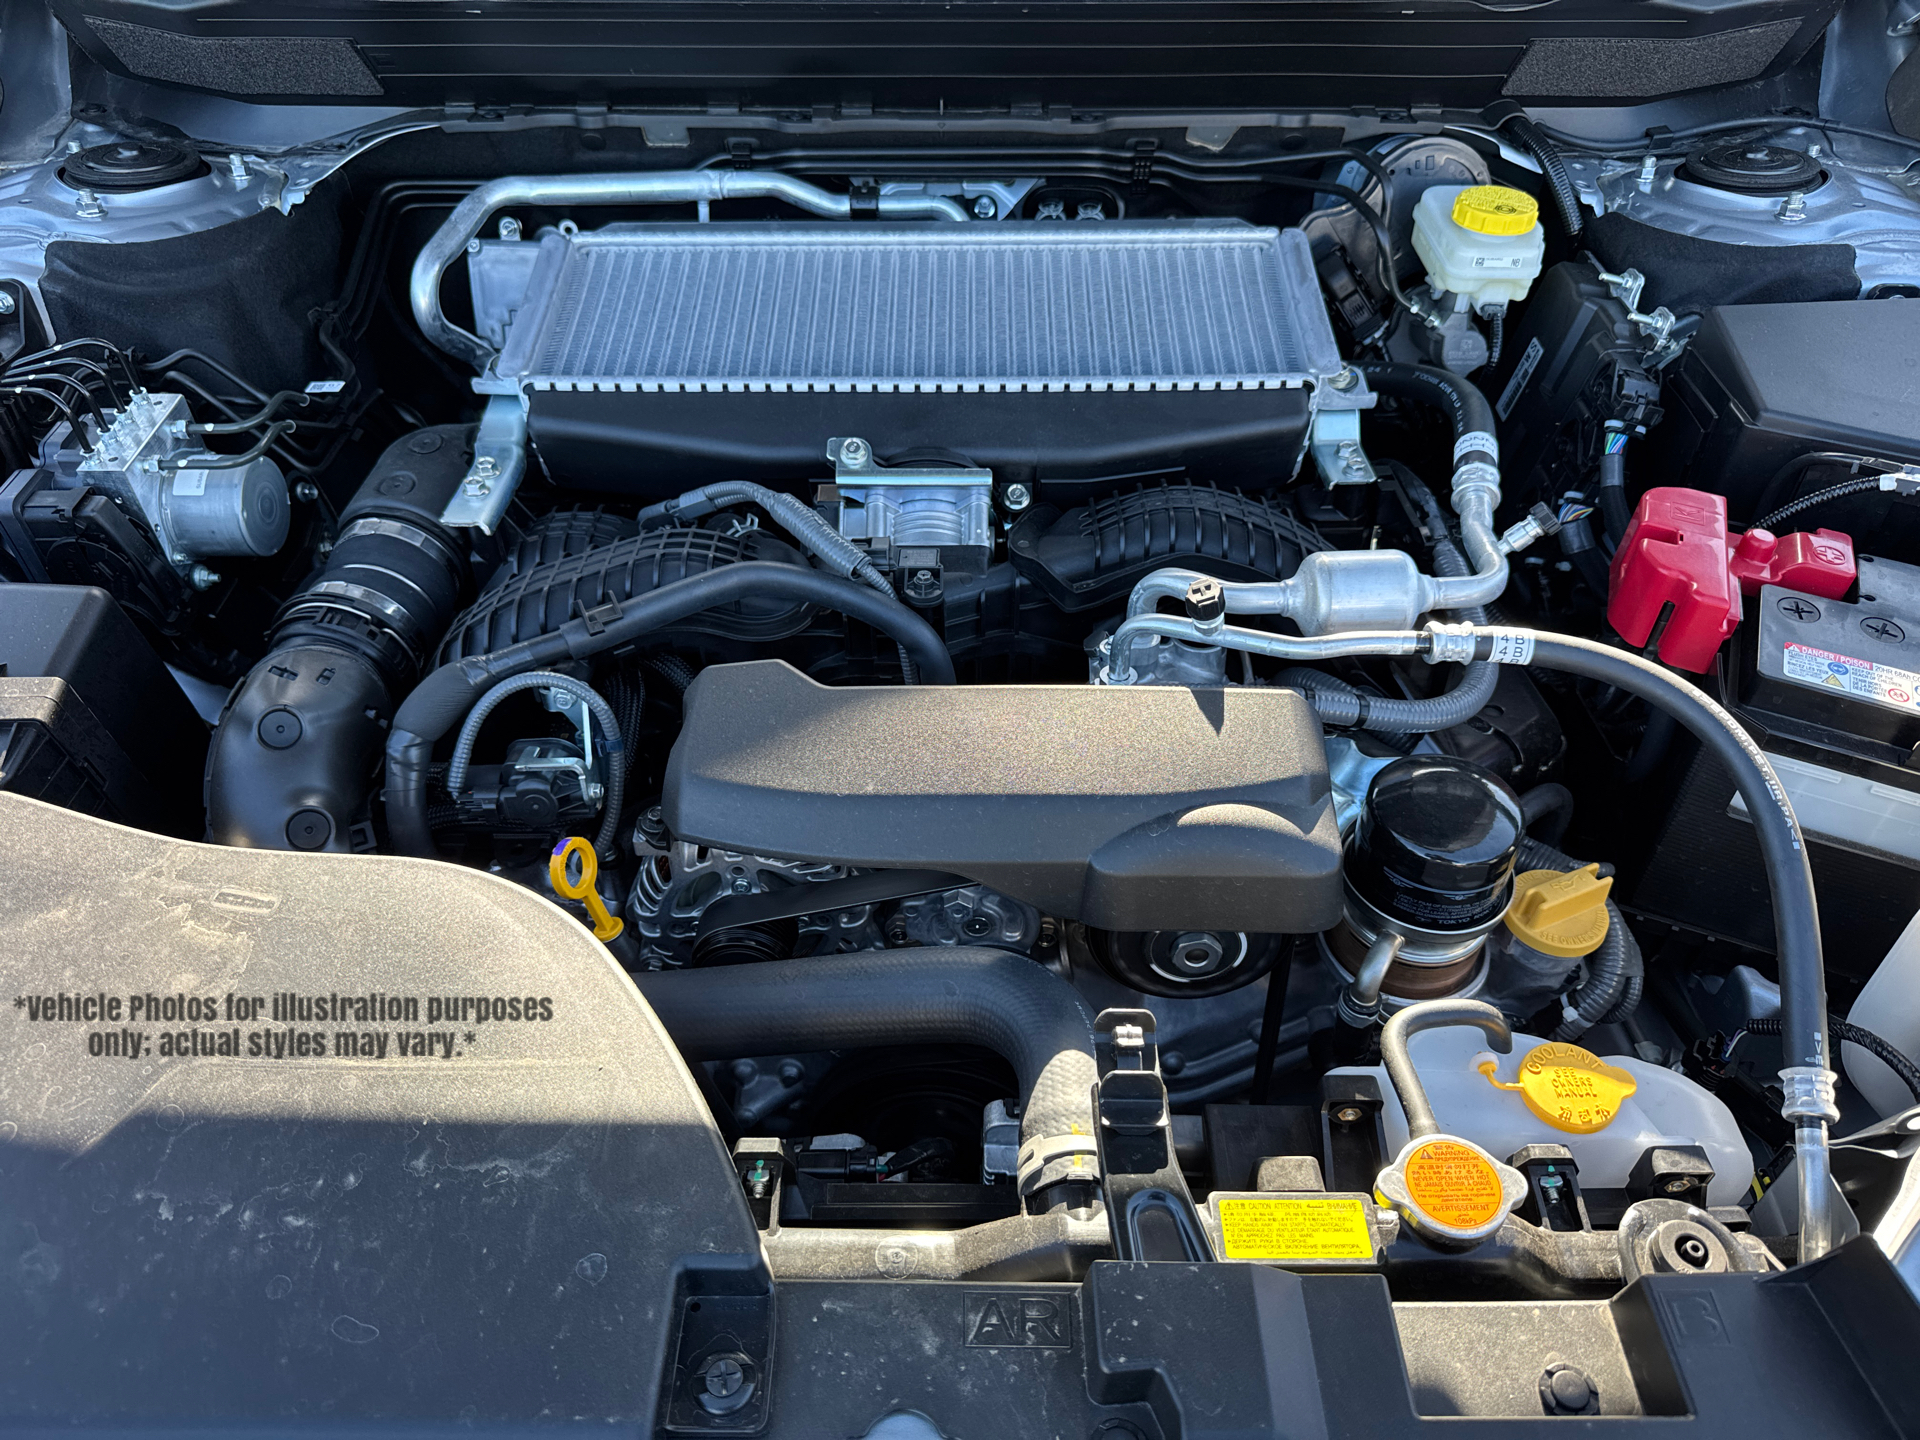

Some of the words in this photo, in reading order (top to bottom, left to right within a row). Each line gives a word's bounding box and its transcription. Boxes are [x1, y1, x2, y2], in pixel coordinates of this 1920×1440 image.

[1801, 646, 1835, 661] DANGER
[1840, 656, 1870, 670] POISON
[1438, 917, 1470, 925] TOKYO
[1541, 930, 1558, 944] SEE
[1526, 1044, 1604, 1075] COOLANT
[1553, 1066, 1576, 1078] SEE
[1553, 1088, 1598, 1099] MANUAL
[1248, 1202, 1272, 1210] CAUTION
[1274, 1202, 1303, 1210] ATTENTION
[1432, 1204, 1490, 1212] AVERTISSEMENT
[1454, 1217, 1477, 1225] 108kPa
[970, 1296, 1061, 1343] AR
